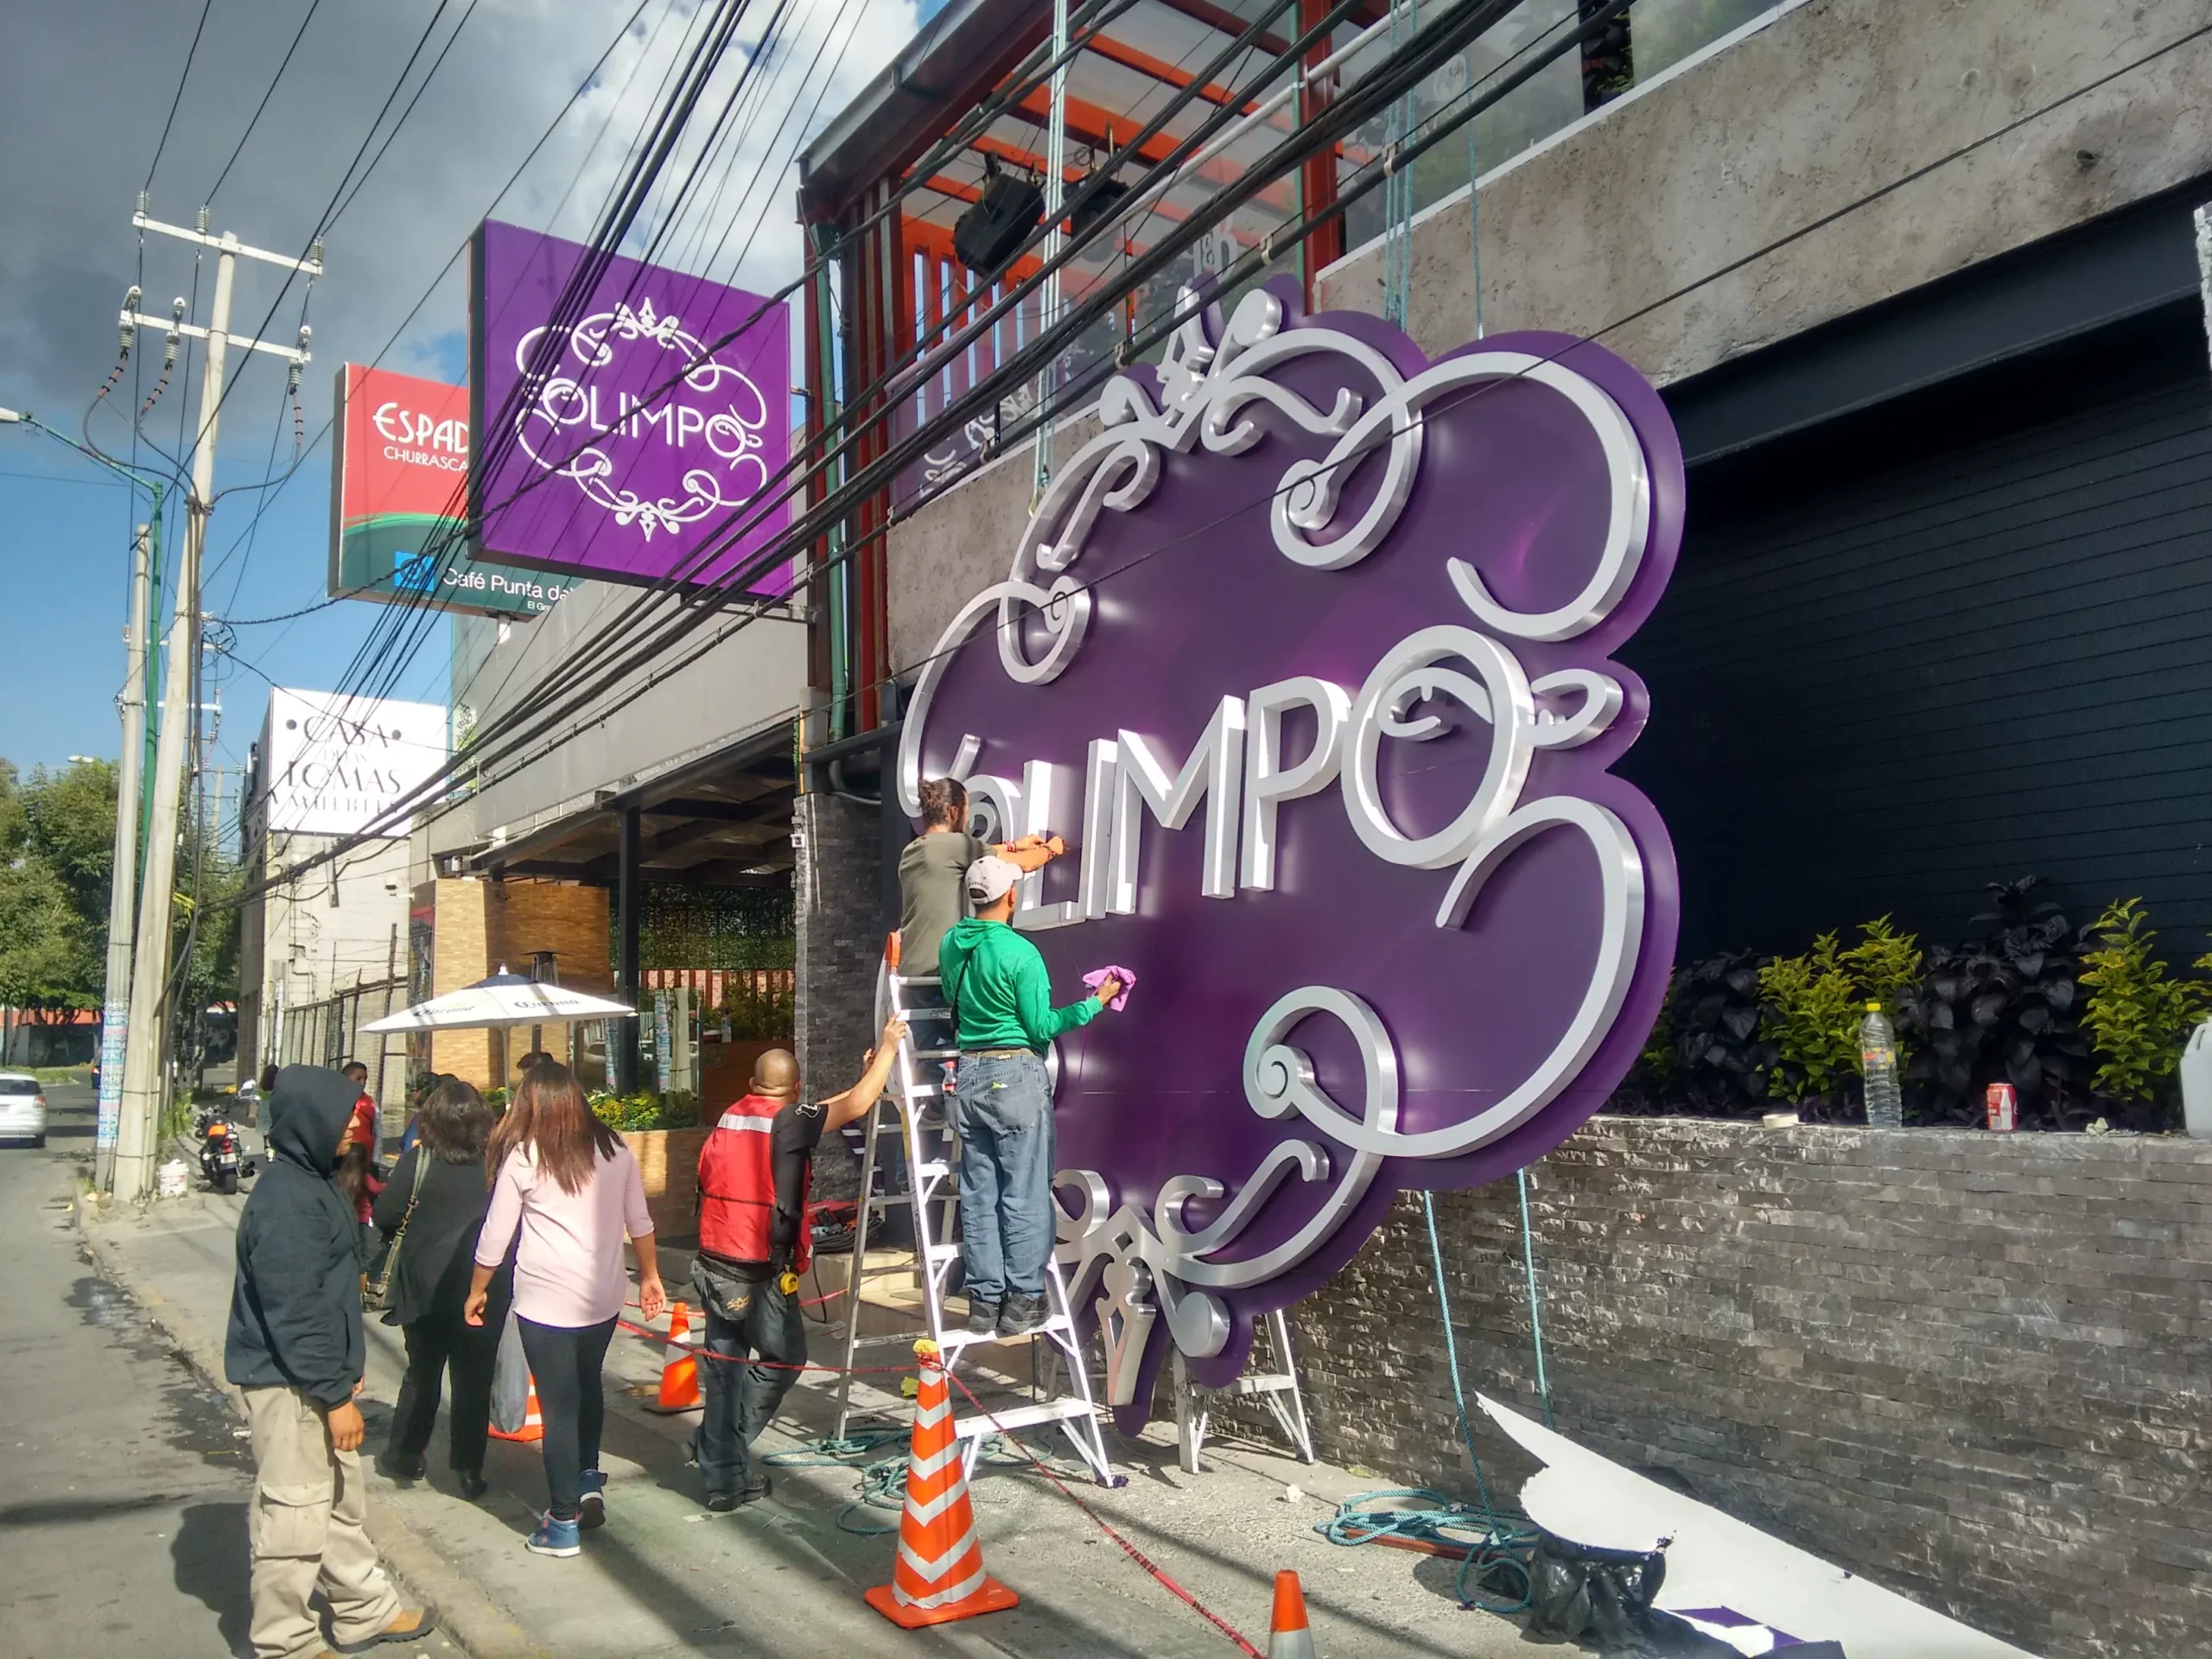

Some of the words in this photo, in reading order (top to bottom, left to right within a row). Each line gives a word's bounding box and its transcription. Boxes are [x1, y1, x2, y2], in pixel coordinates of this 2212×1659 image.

[543, 378, 746, 458] OLIMPO
[442, 567, 486, 590] Café
[491, 575, 543, 599] Punta
[547, 585, 575, 601] de
[303, 715, 389, 749] CASA
[288, 760, 401, 795] LOMAS
[949, 625, 1535, 931] LIMPO
[513, 998, 582, 1009] Corona
